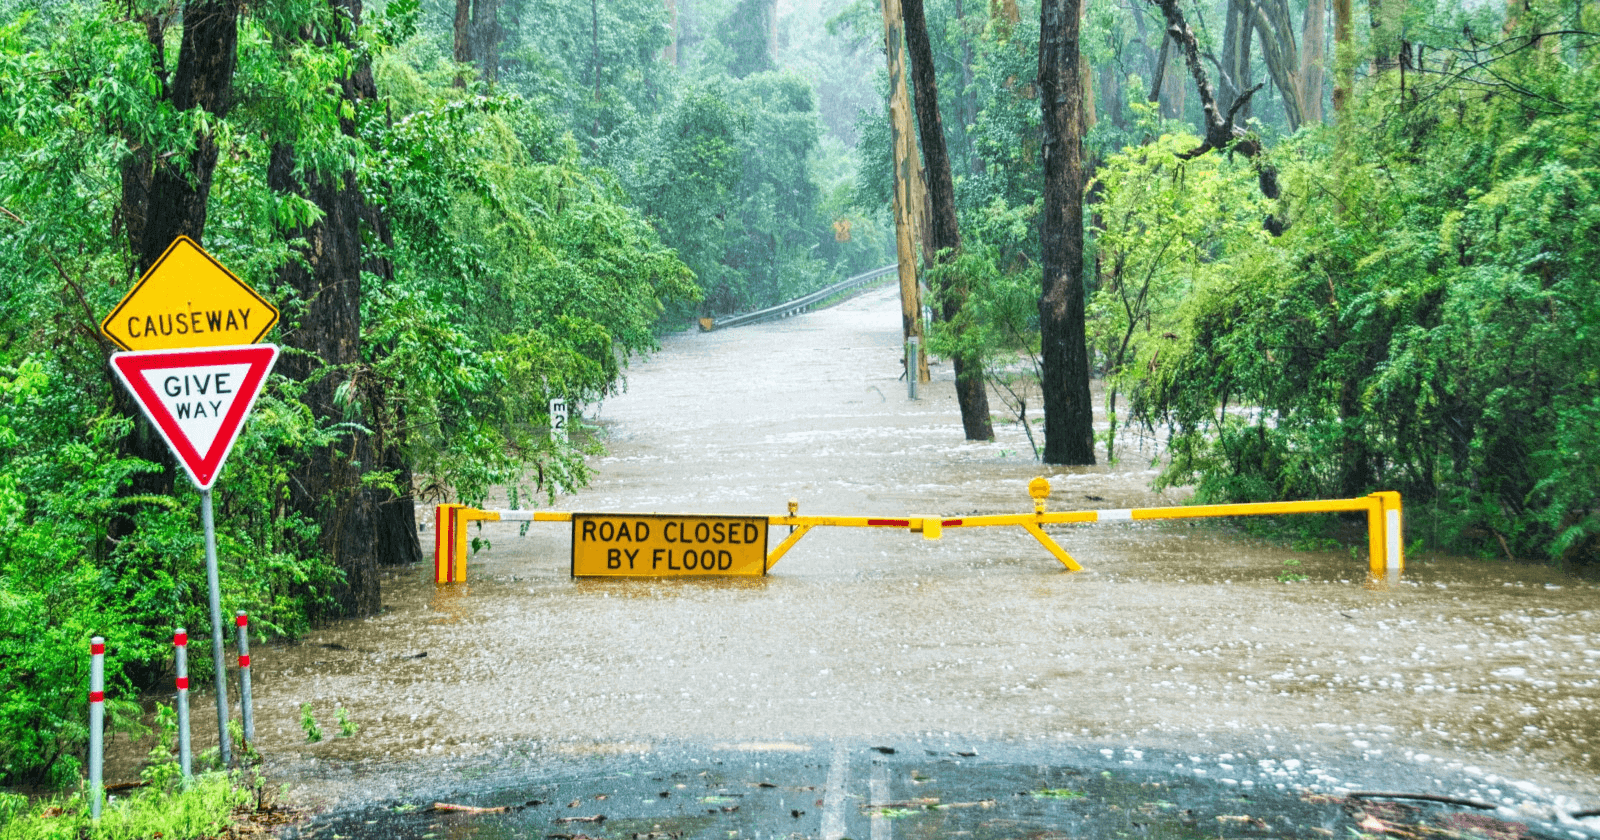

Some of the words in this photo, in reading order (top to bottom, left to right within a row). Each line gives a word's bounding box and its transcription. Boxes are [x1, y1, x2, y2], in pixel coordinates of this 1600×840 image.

[127, 308, 251, 338] CAUSEWAY
[164, 373, 232, 397] GIVE
[176, 400, 222, 420] WAY
[555, 415, 565, 429] 2
[582, 520, 650, 543] ROAD
[663, 521, 759, 544] CLOSED
[607, 548, 640, 570] BY
[652, 548, 733, 571] FLOOD
